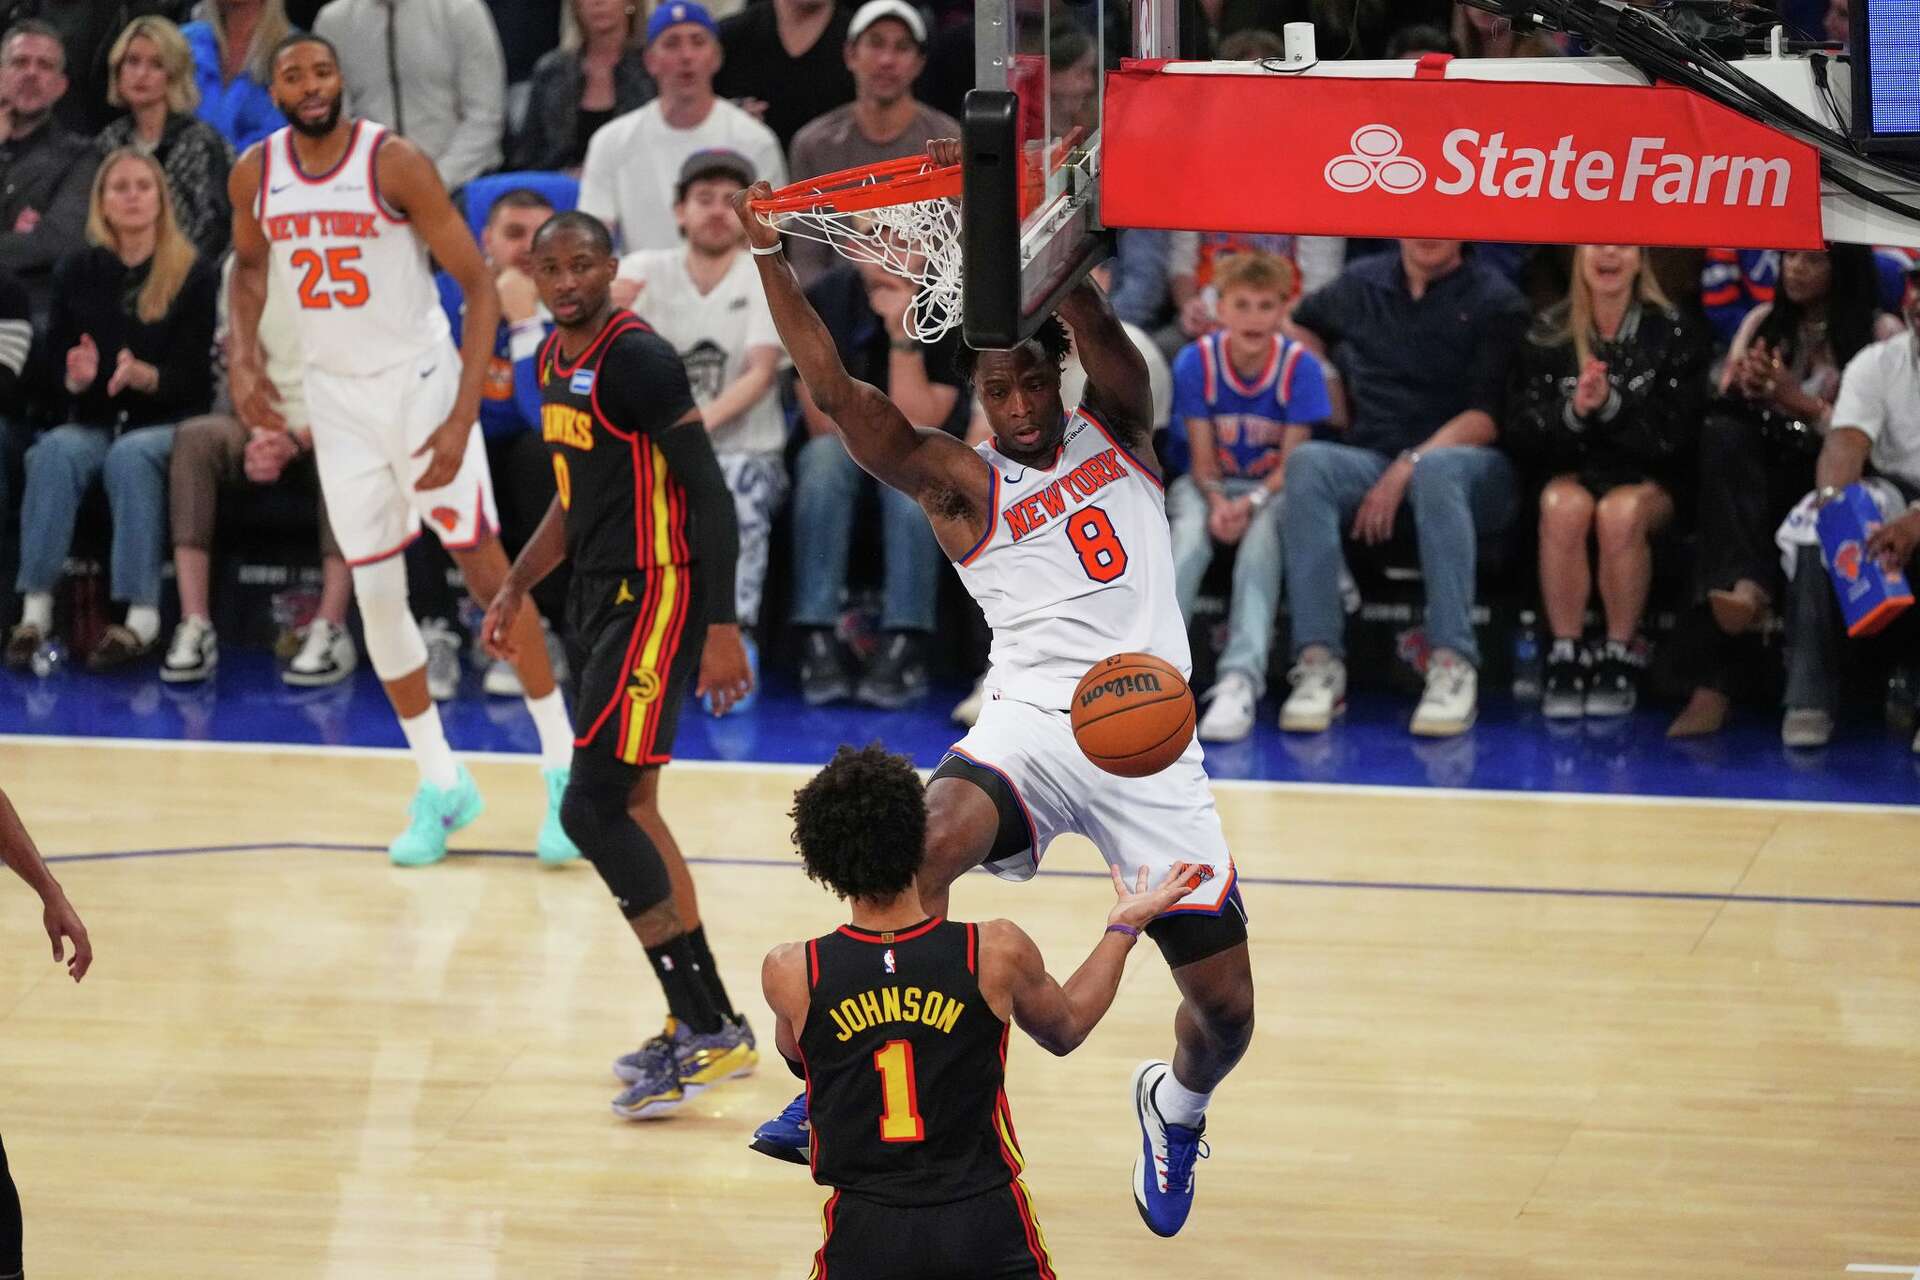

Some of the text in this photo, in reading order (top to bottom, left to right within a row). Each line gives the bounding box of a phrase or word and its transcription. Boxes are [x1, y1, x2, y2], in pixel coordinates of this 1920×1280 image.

[289, 246, 370, 310] 25
[1001, 447, 1130, 543] NEW YORK
[1065, 504, 1128, 584] 8
[1080, 672, 1162, 708] Wilson
[828, 986, 965, 1042] JOHNSON
[873, 1038, 925, 1142] 1
